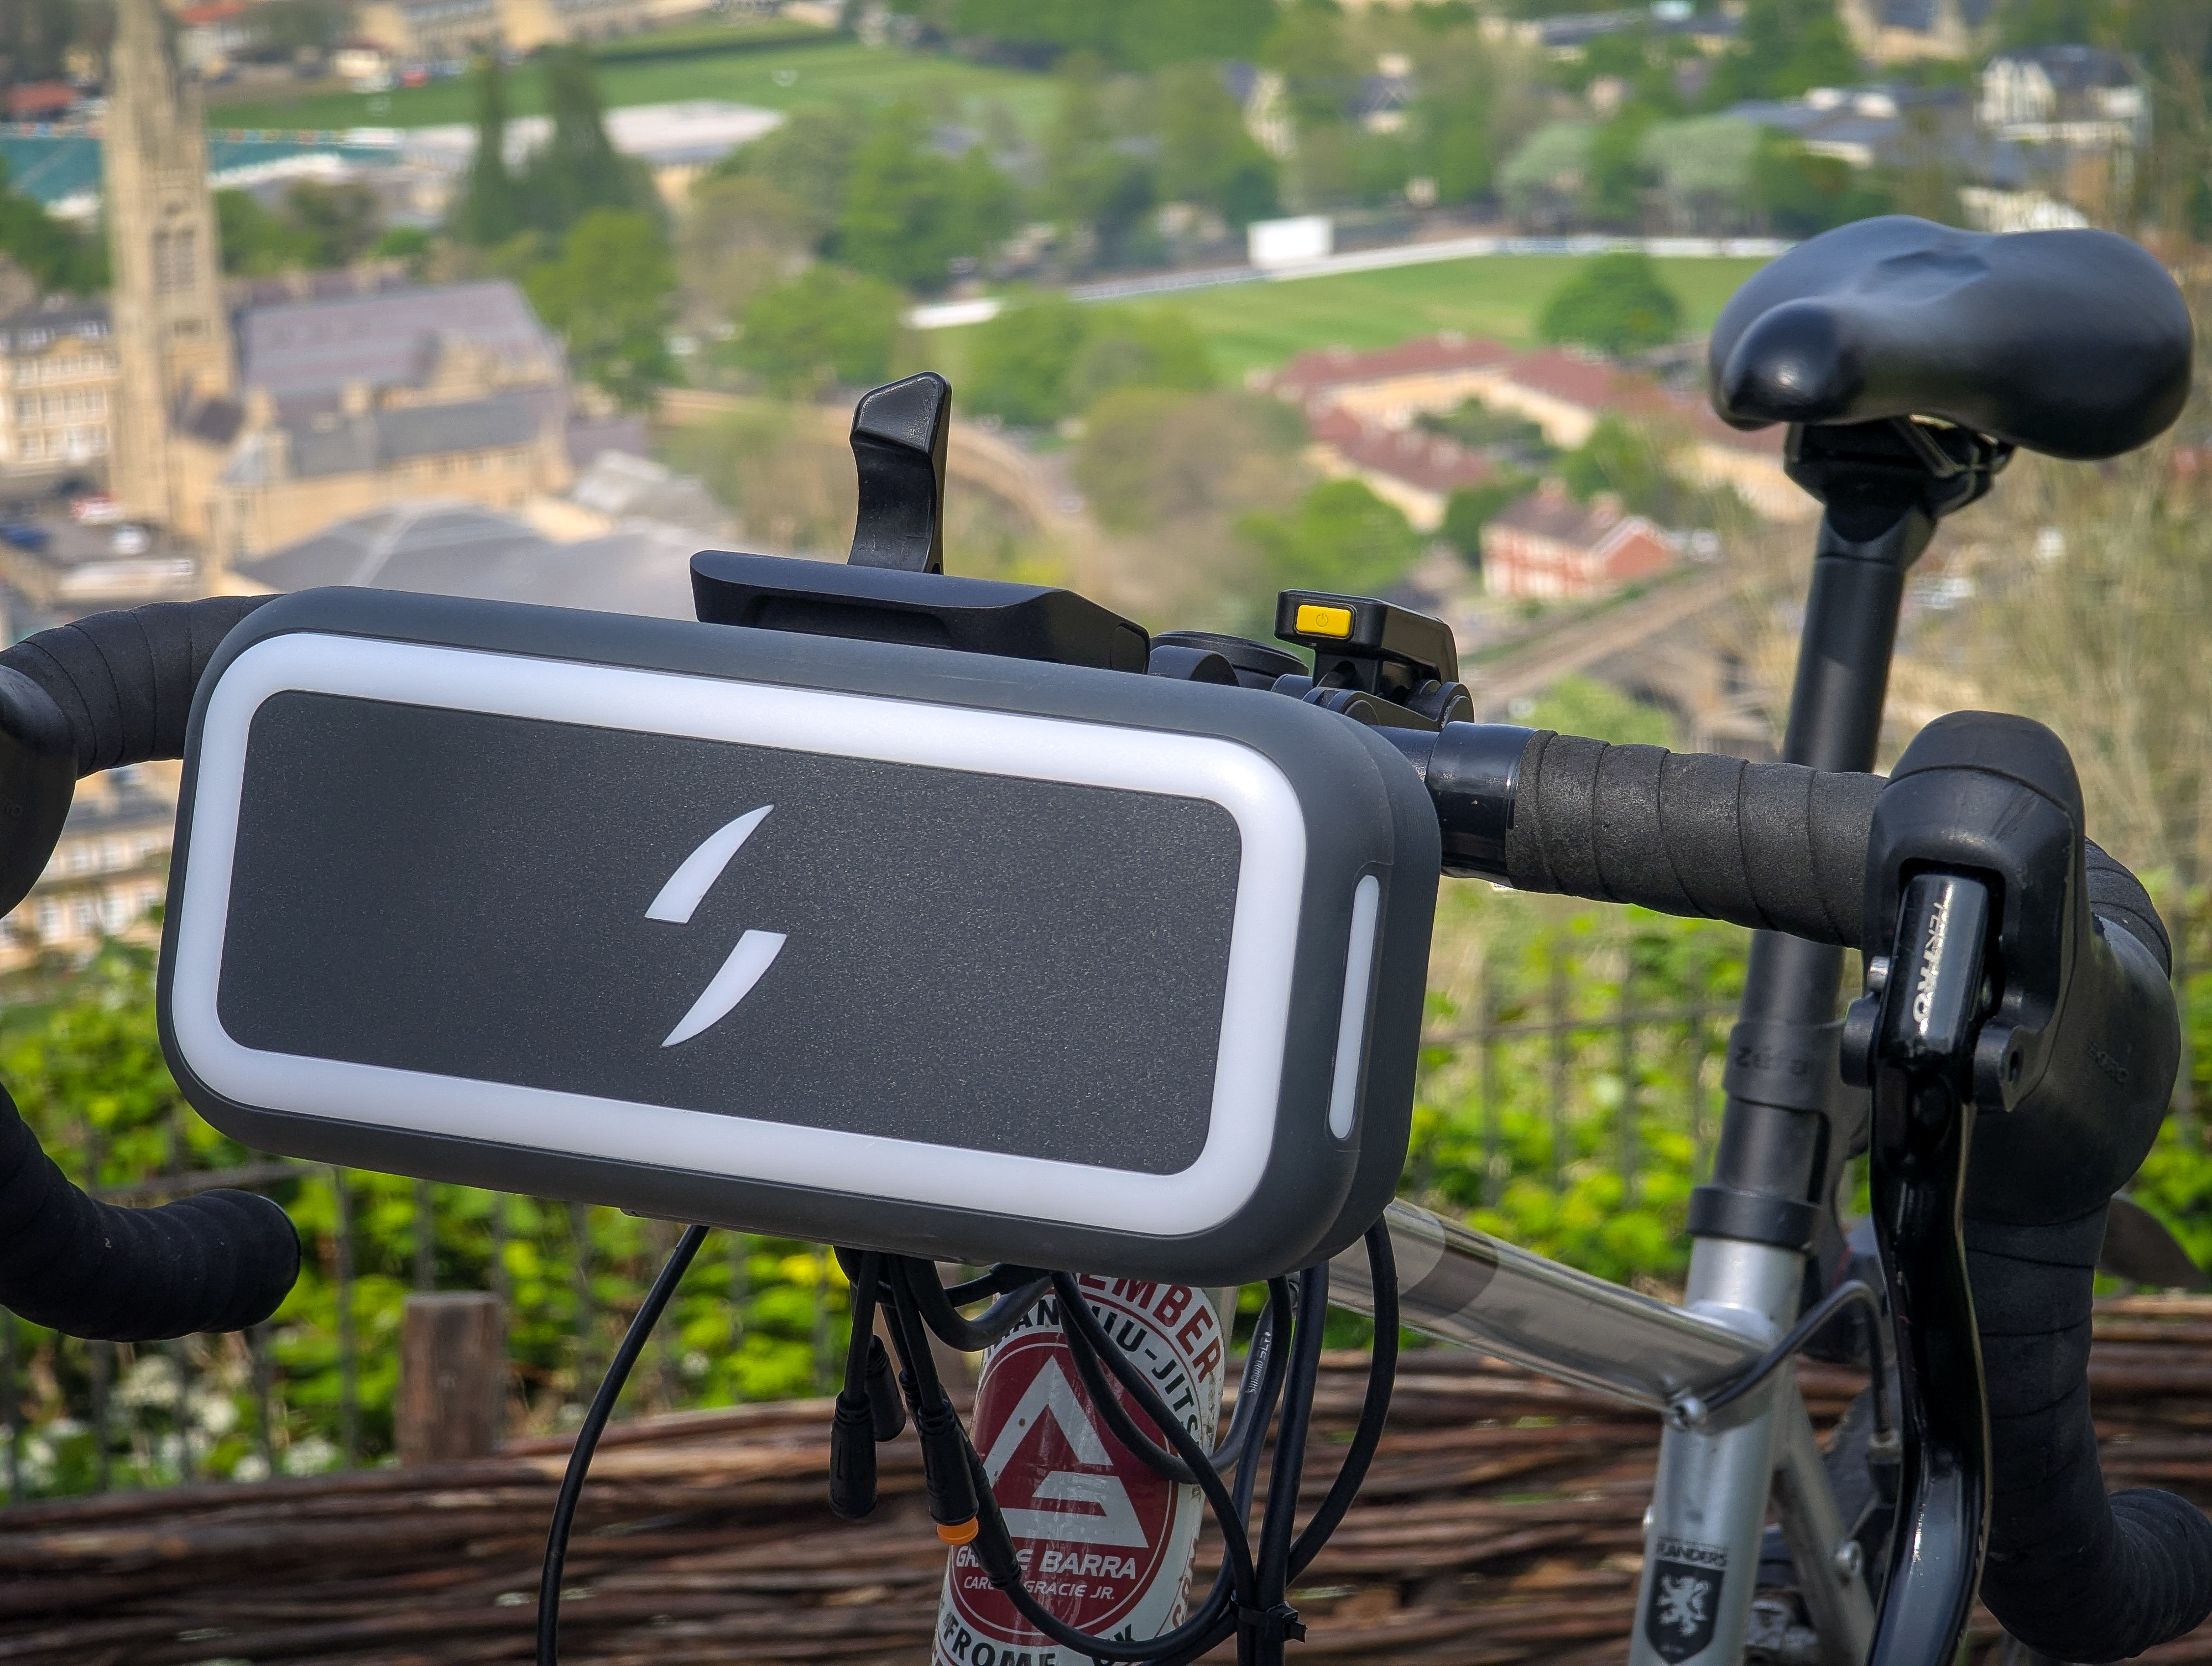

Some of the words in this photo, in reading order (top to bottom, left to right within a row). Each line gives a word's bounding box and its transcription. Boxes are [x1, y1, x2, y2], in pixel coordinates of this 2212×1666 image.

[1039, 1550, 1135, 1579] BARRA
[1024, 1580, 1087, 1597] GRACIE
[1090, 1585, 1115, 1600] JR.
